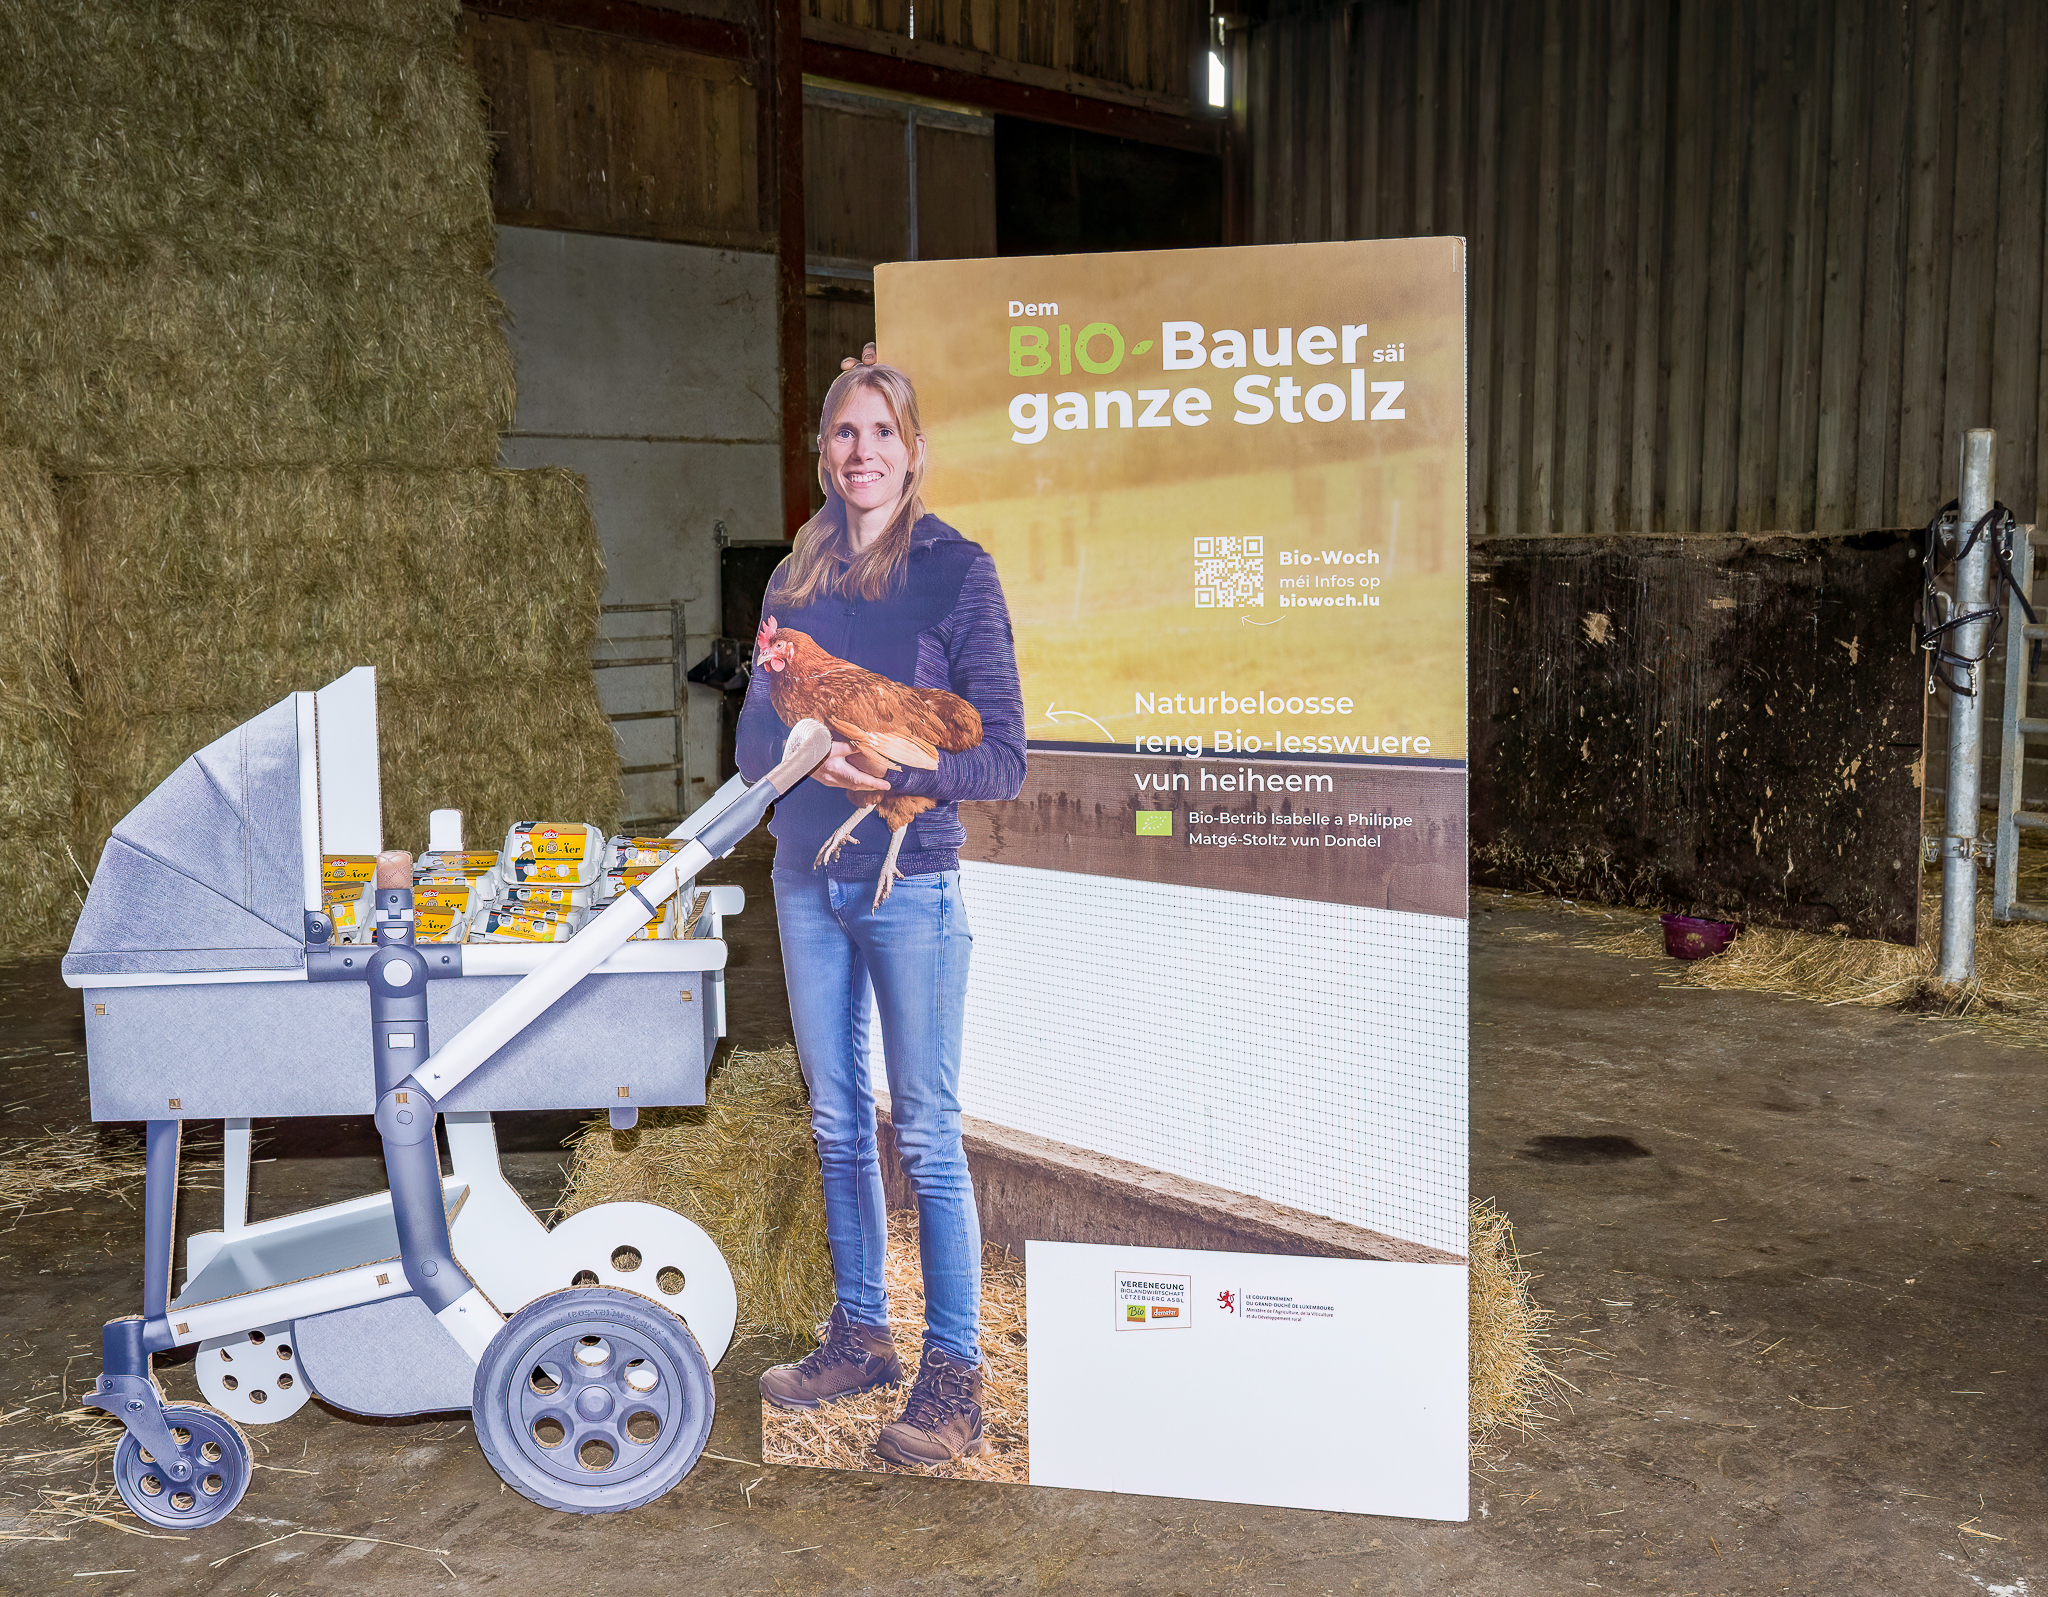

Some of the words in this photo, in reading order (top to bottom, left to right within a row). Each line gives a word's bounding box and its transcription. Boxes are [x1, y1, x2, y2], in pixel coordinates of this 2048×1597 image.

[1008, 300, 1059, 317] Dem
[1161, 320, 1368, 370] Bauer
[1372, 343, 1405, 363] säi
[1008, 387, 1212, 445] ganze
[1233, 368, 1406, 426] Stolz
[1279, 549, 1380, 566] Bio-Woch
[1280, 575, 1310, 588] méi
[1315, 574, 1355, 588] Infos
[1359, 576, 1381, 590] op
[1279, 593, 1380, 608] biowoch.lu
[1134, 690, 1354, 715] Naturbeloosse
[1134, 734, 1204, 759] reng
[1133, 772, 1190, 791] vun
[1200, 767, 1333, 793] heiheem
[1189, 811, 1267, 825] Bio-Betrib
[1271, 812, 1331, 826] Isabelle
[1334, 816, 1344, 826] a
[1348, 812, 1413, 830] Philippe
[1189, 832, 1287, 848] Matgé-Stoltz
[1290, 837, 1320, 846] vun
[1324, 834, 1382, 848] Dondel
[538, 844, 544, 854] 6
[1120, 1280, 1184, 1290] VEREENEGUNG
[1120, 1288, 1184, 1296] BIOLANDWIRTSCHAFT
[1128, 1306, 1144, 1316] Bio
